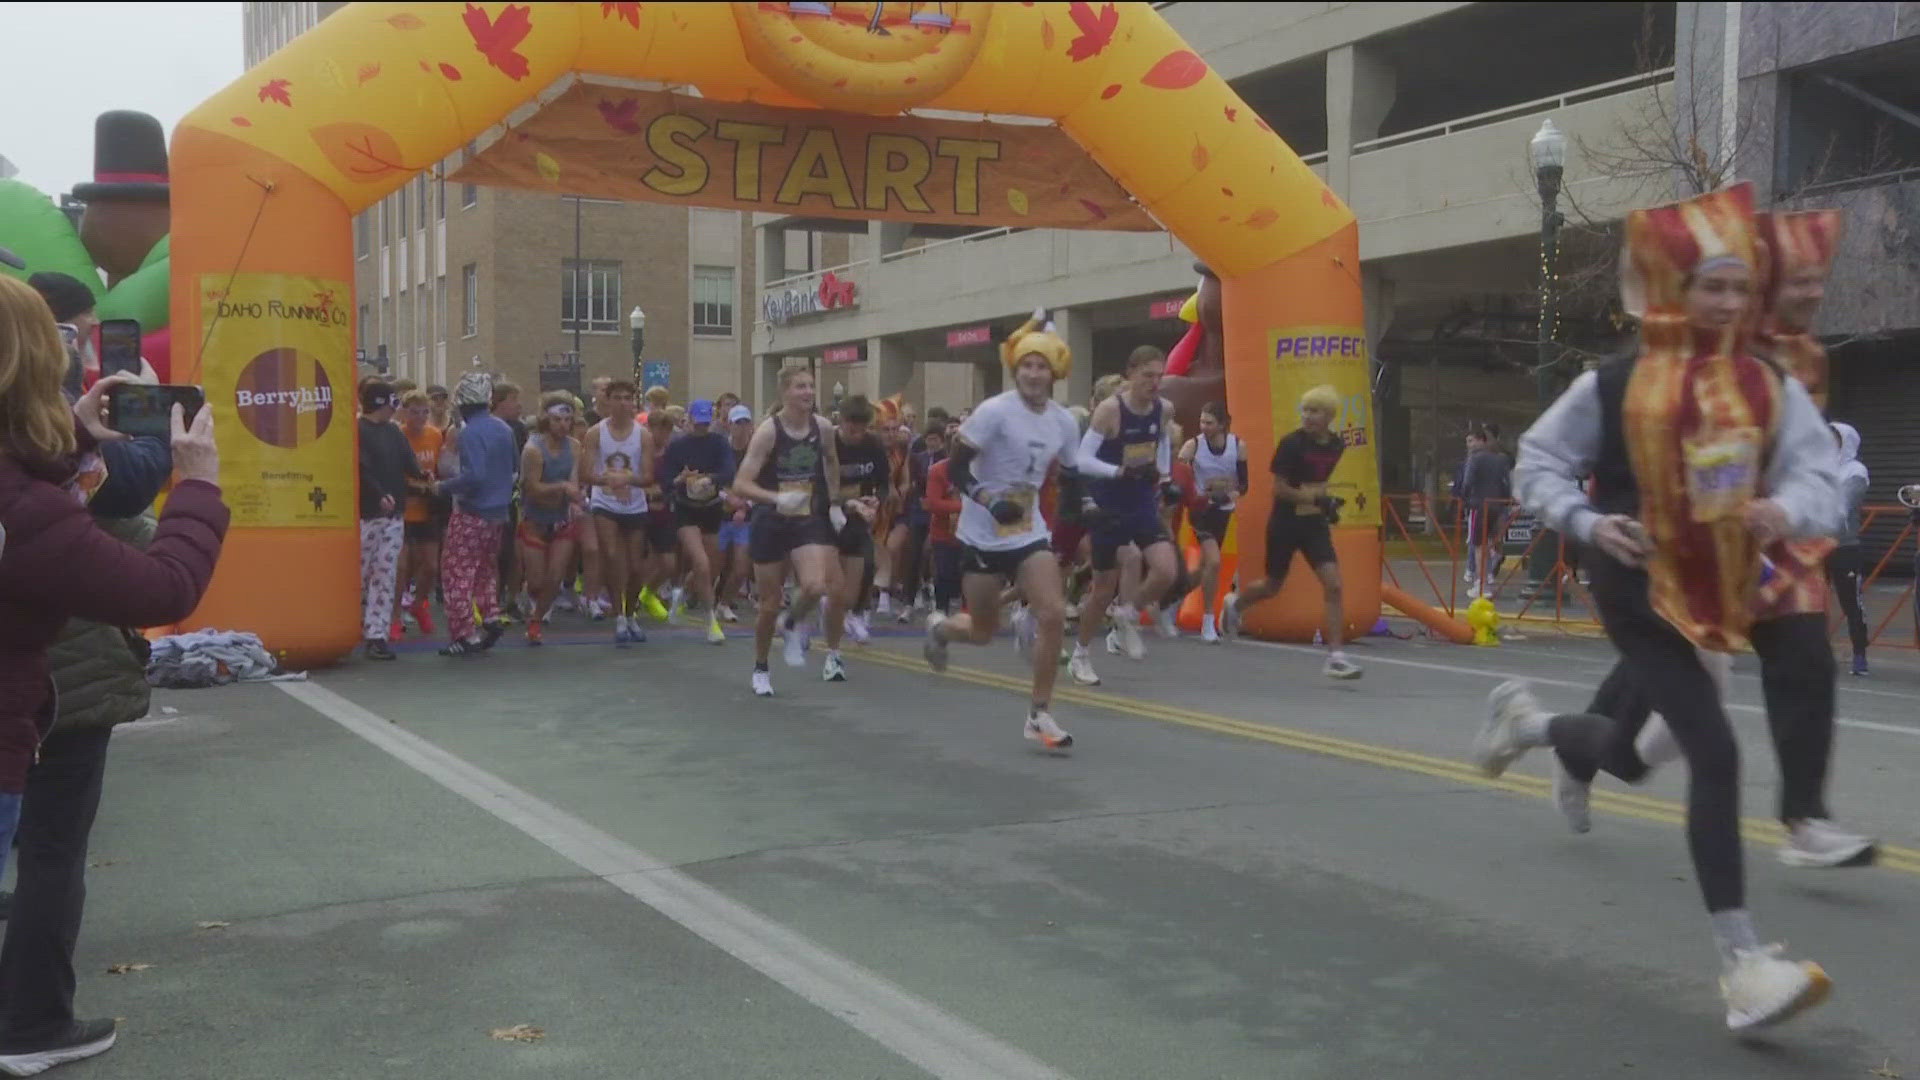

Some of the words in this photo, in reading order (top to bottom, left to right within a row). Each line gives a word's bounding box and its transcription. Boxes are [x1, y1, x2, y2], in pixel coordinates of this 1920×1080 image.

[640, 113, 1001, 216] START
[217, 301, 263, 320] IDAHO
[267, 300, 330, 323] RUNNING
[763, 286, 818, 324] KeyBank
[236, 386, 332, 408] Berryhill
